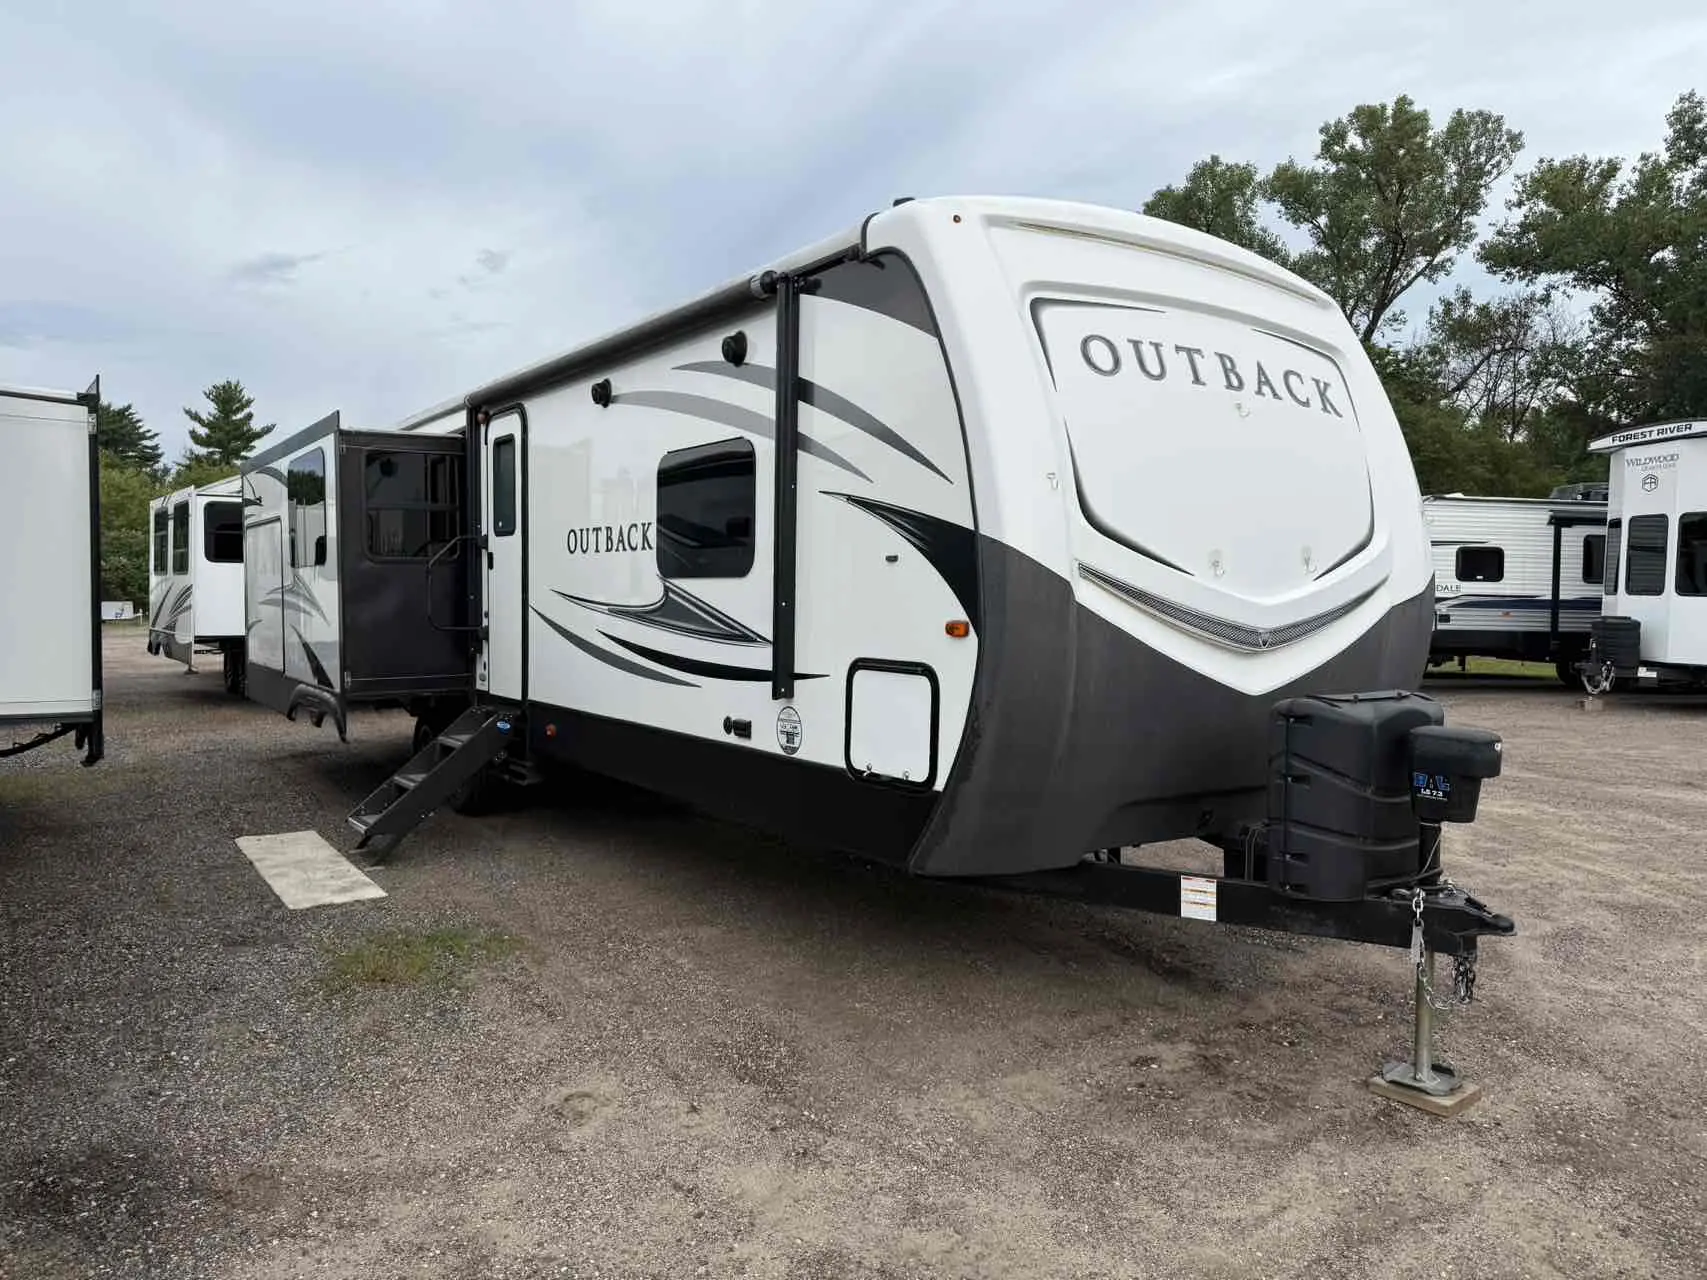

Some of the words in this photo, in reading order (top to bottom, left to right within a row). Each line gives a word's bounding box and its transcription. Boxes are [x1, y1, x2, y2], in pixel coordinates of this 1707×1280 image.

[1079, 334, 1344, 418] OUTBACK
[1611, 430, 1655, 444] FOREST
[1656, 423, 1693, 436] RIVER
[567, 521, 653, 554] OUTBACK
